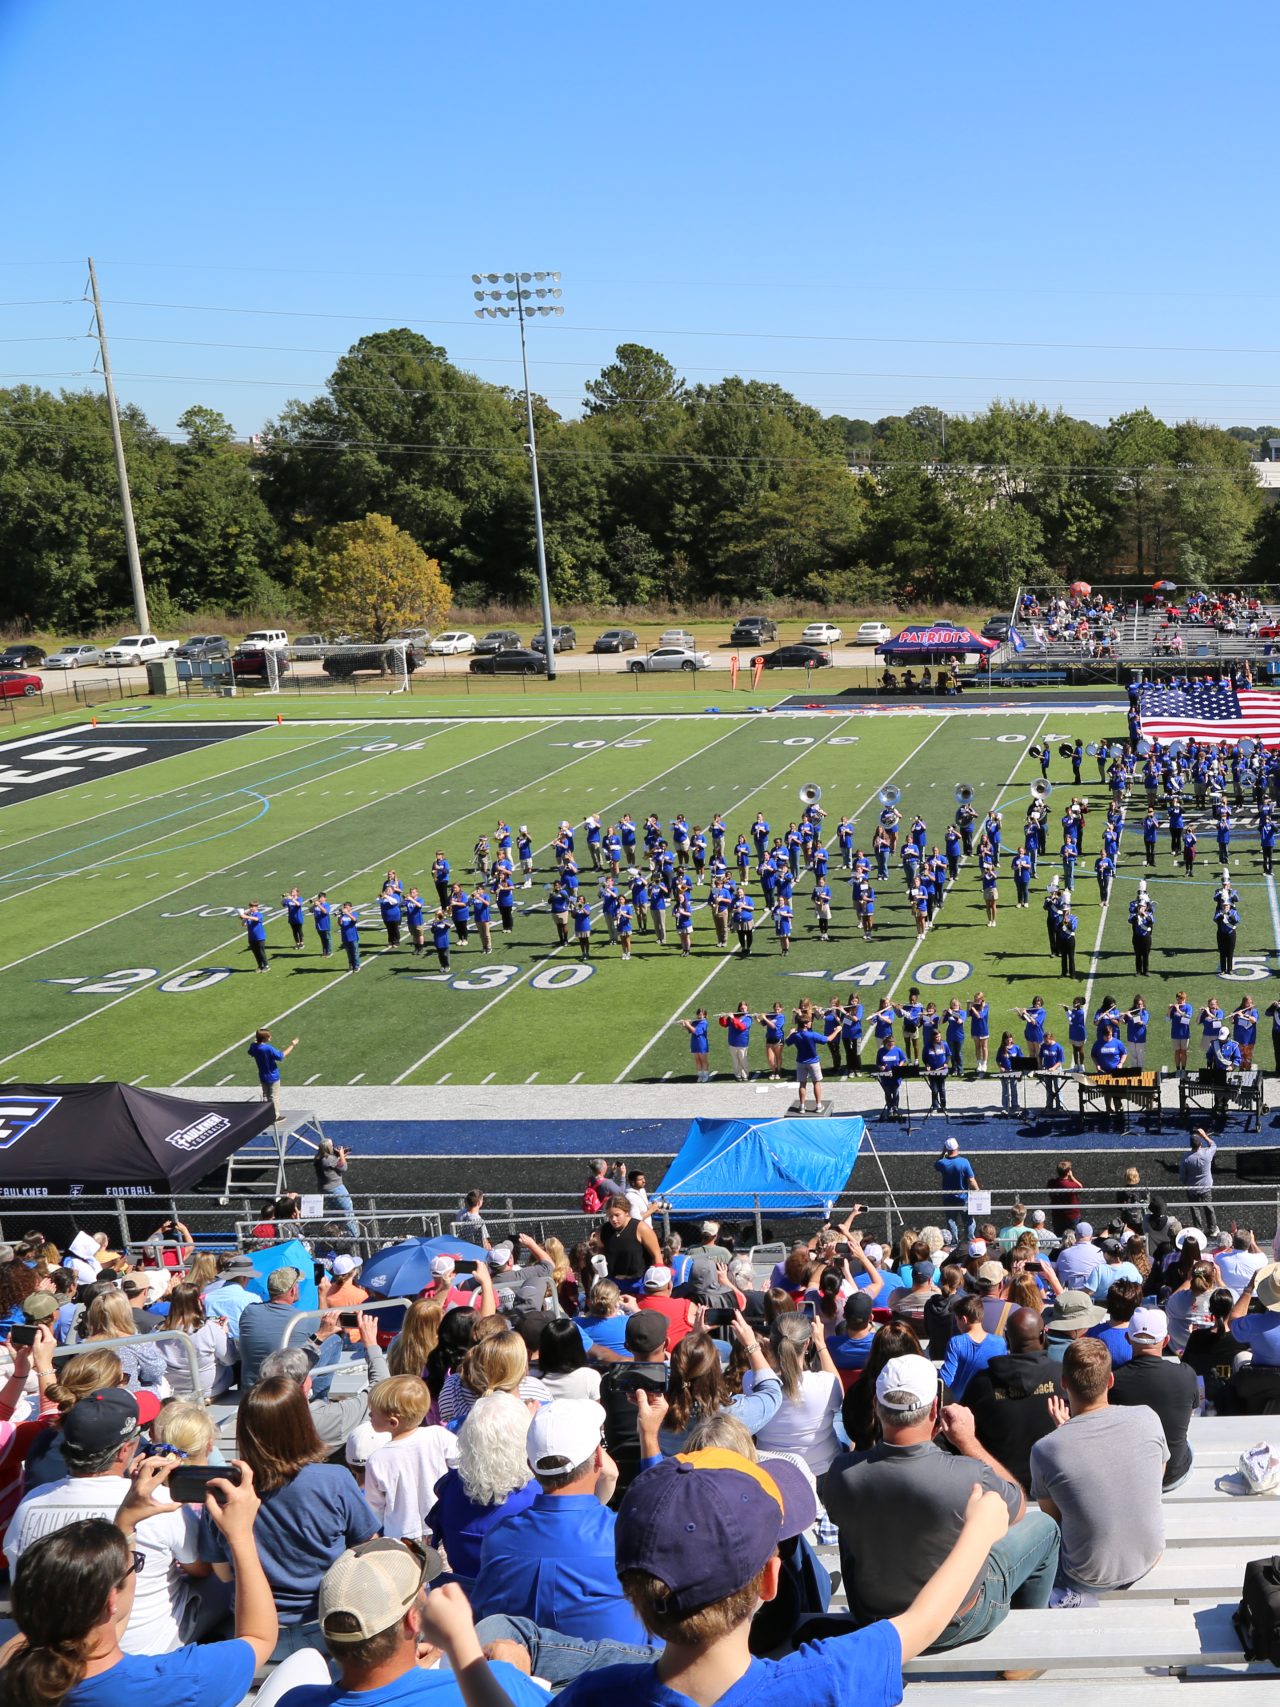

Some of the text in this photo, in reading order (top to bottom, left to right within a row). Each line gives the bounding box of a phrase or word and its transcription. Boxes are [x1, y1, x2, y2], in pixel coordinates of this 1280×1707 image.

[899, 631, 971, 643] PATRIOTS
[782, 736, 860, 746] 30
[67, 967, 233, 993] 20
[450, 964, 597, 991] 30
[827, 959, 973, 987] 40
[173, 1115, 222, 1147] FAULKNER
[106, 1186, 155, 1195] FOOTBALL
